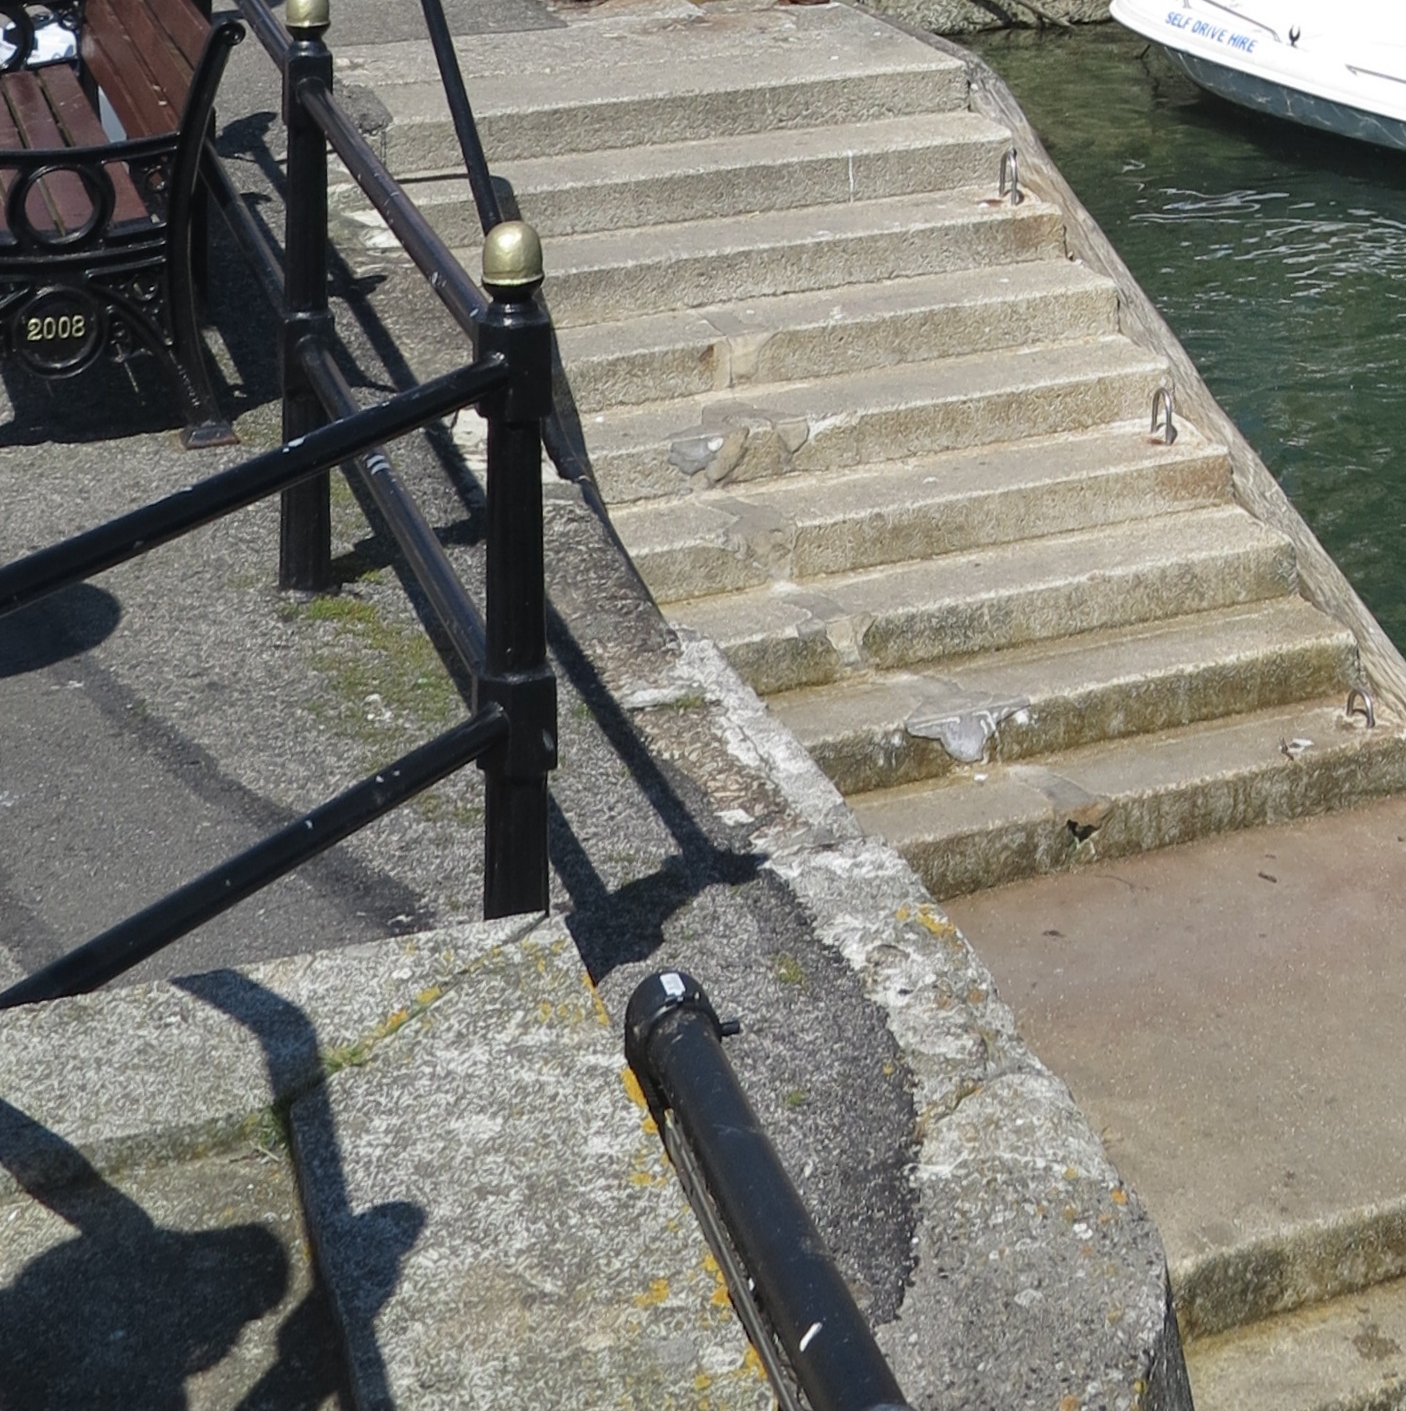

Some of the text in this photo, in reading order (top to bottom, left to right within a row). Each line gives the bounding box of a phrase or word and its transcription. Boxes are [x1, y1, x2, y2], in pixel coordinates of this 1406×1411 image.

[1165, 11, 1258, 53] SELF DRIVE HIRE
[27, 315, 85, 341] 2008
